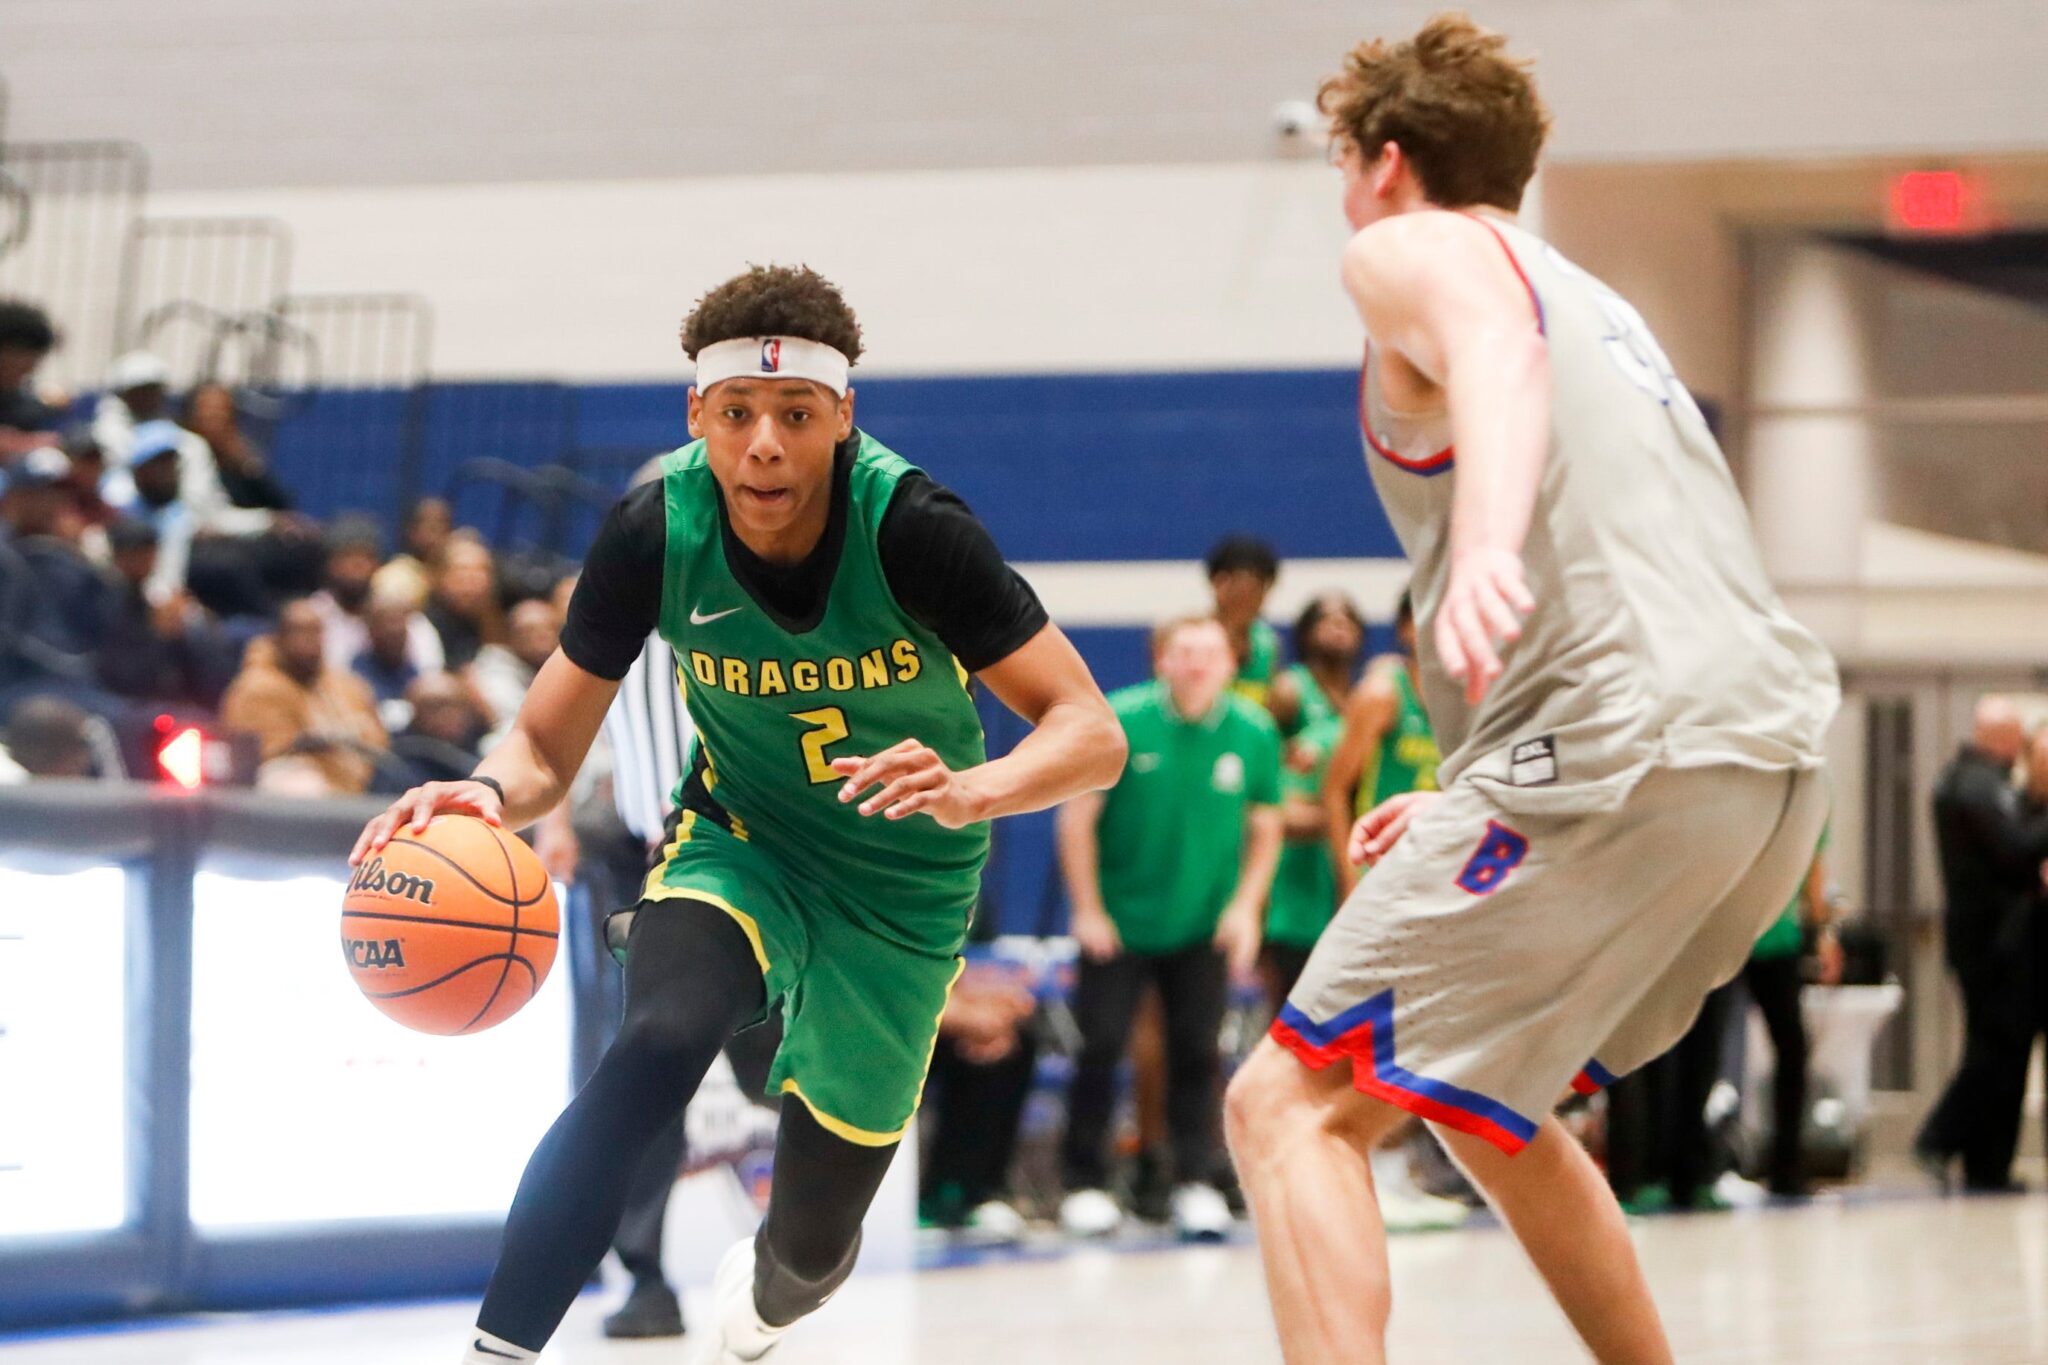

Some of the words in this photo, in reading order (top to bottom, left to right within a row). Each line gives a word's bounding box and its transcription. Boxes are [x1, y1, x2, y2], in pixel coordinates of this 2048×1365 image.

[690, 638, 922, 697] DRAGONS
[788, 706, 851, 786] 2
[1454, 819, 1530, 896] B
